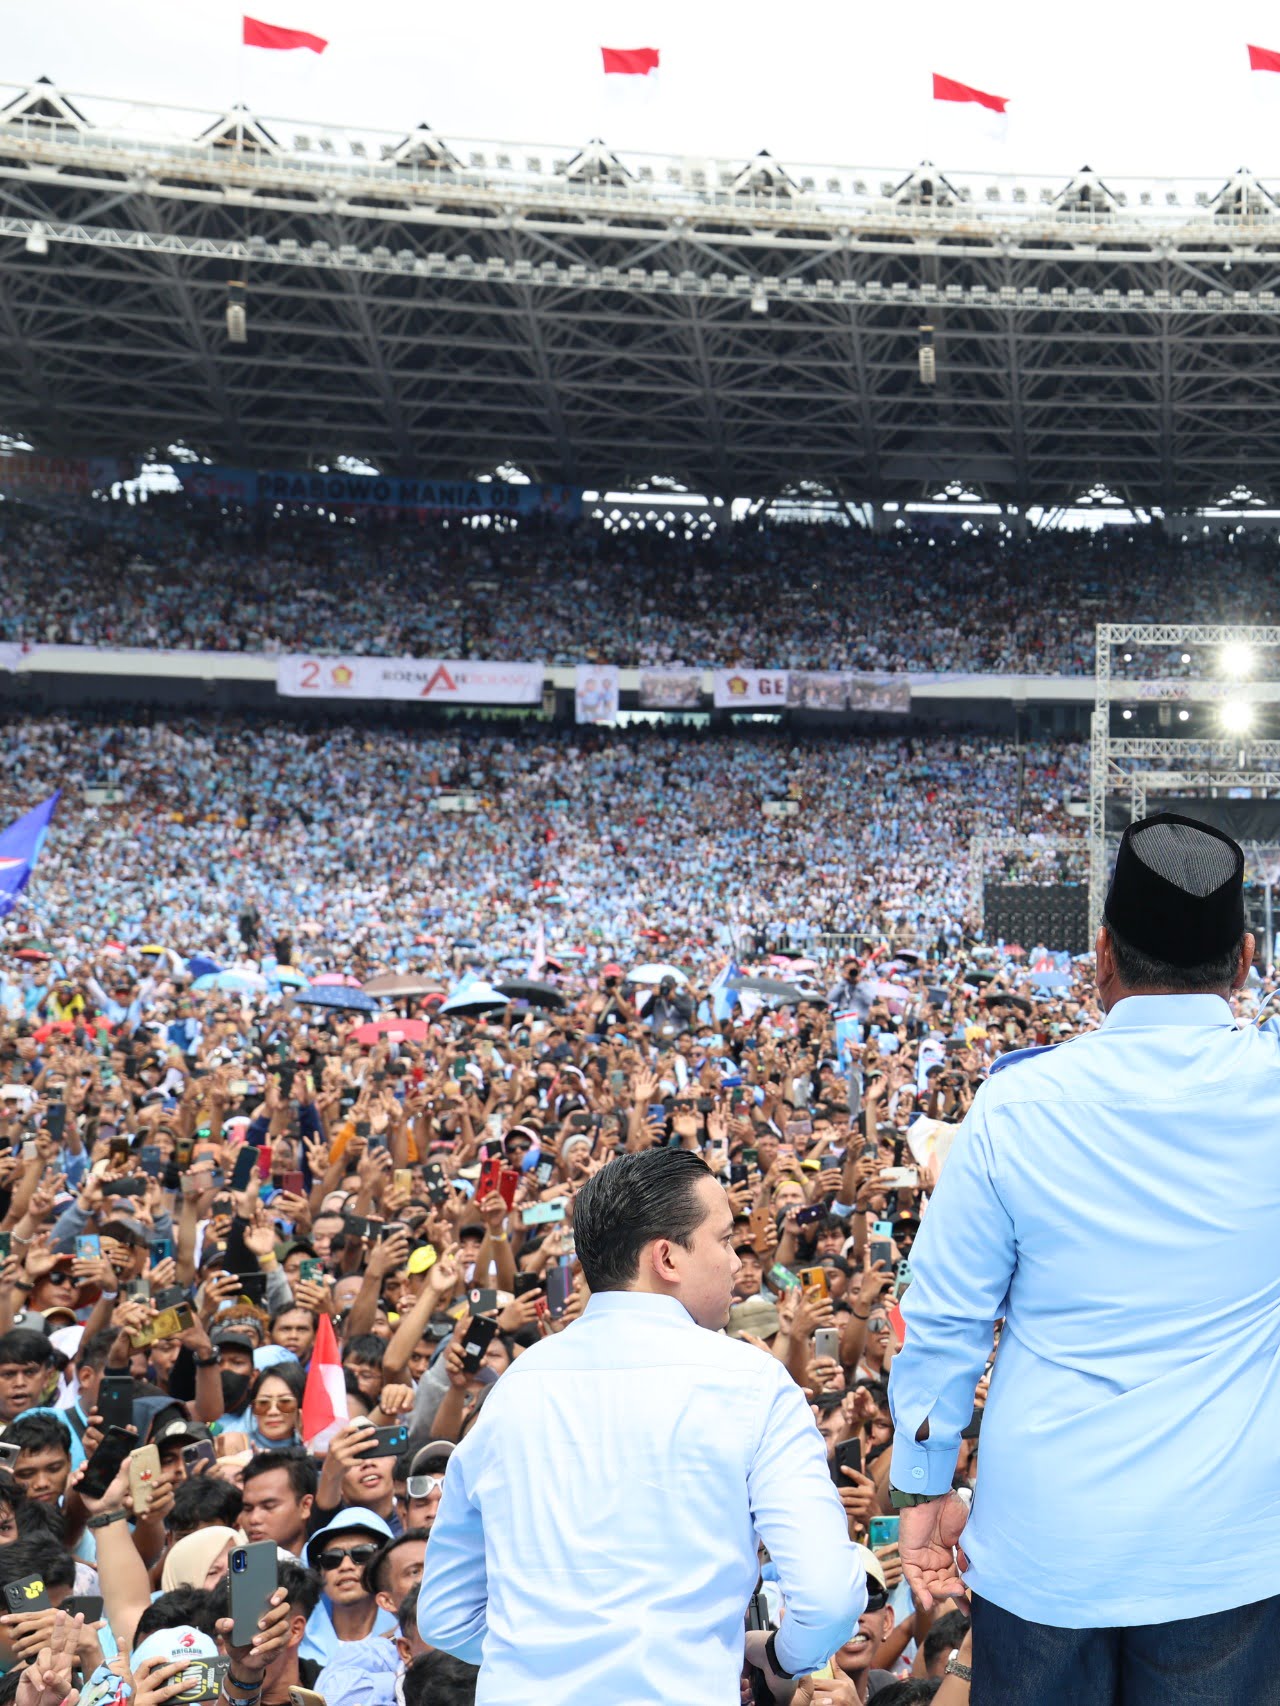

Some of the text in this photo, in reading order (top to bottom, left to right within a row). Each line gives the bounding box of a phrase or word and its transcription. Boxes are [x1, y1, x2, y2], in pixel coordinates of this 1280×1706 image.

[255, 475, 393, 500] PRABOWO
[402, 482, 480, 502] MANIA
[301, 661, 320, 689] 2
